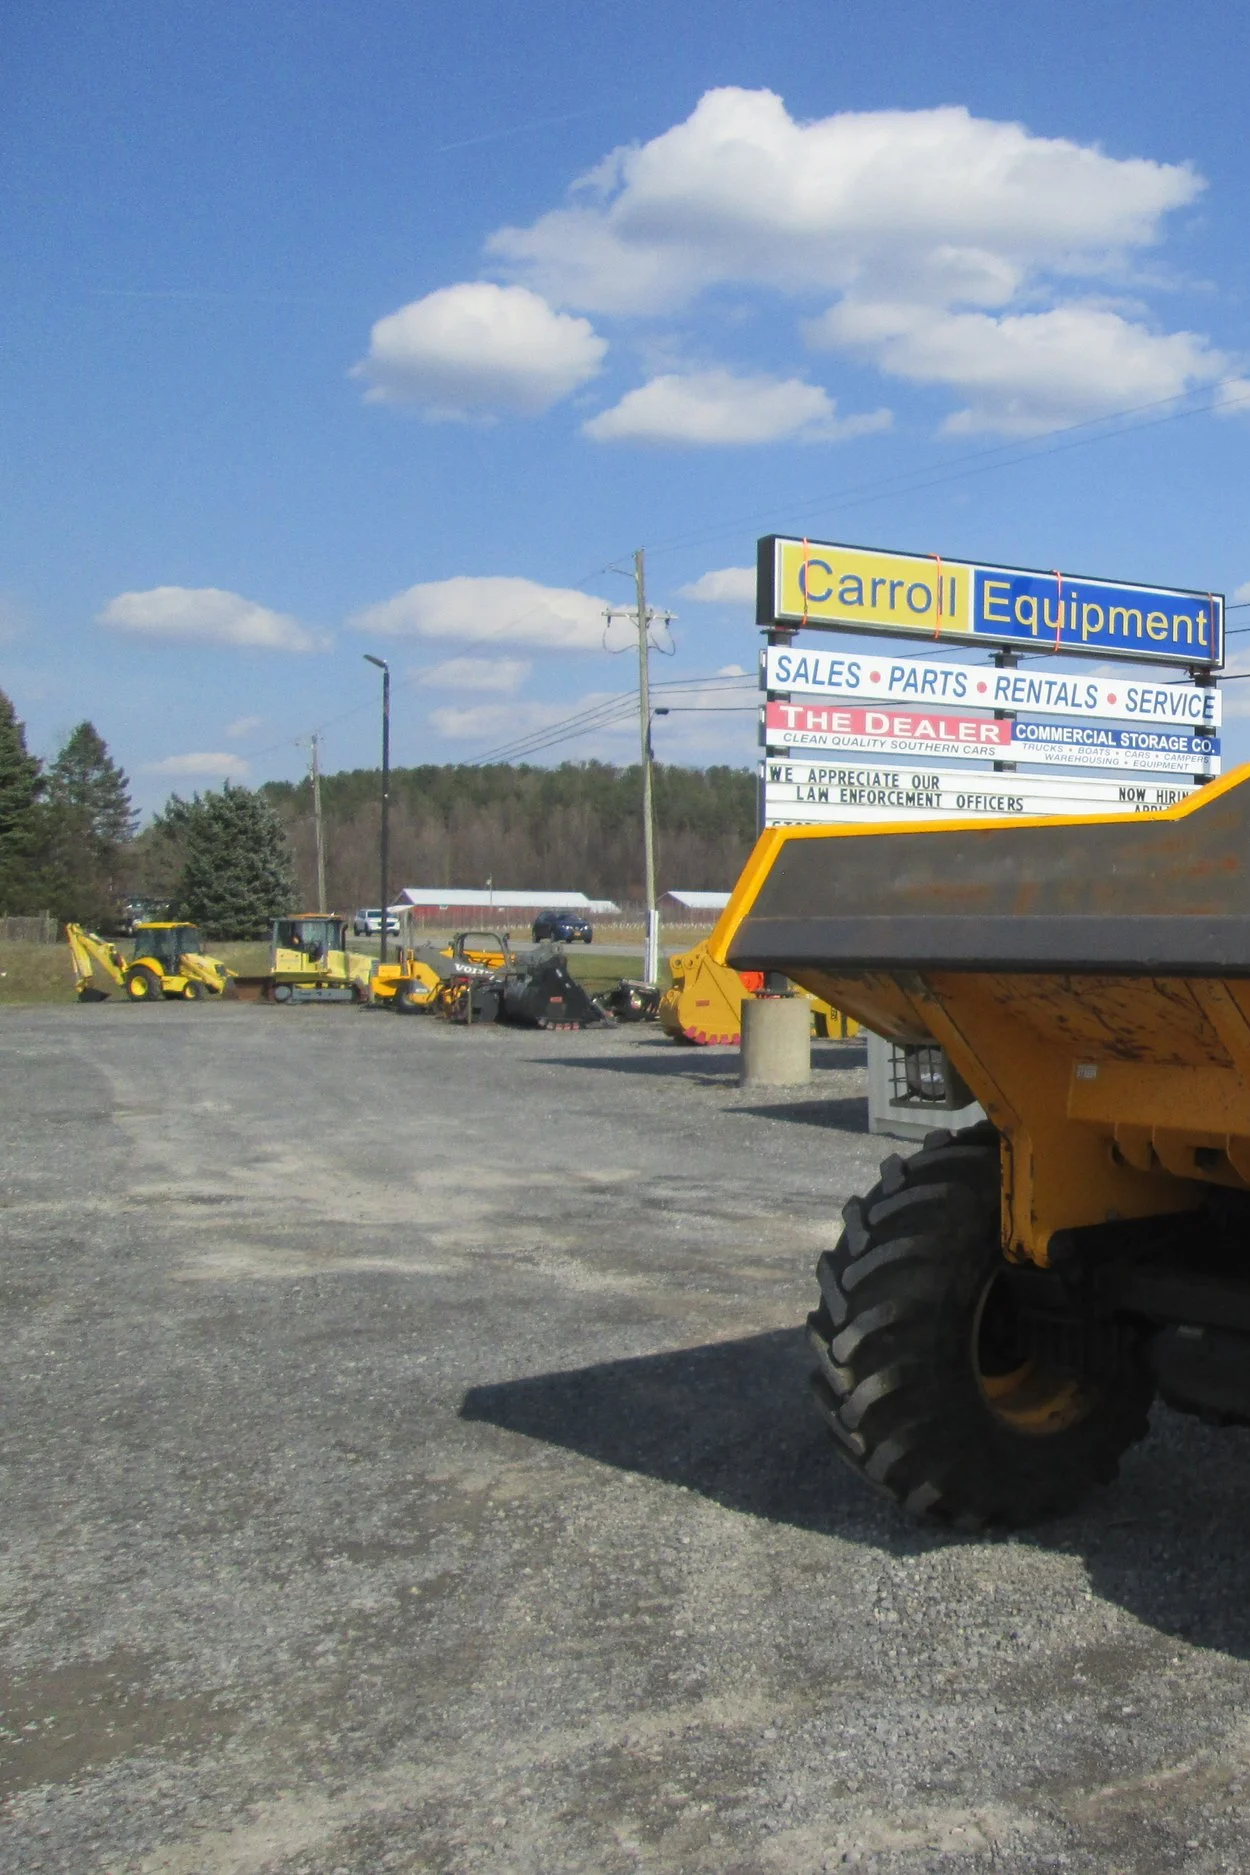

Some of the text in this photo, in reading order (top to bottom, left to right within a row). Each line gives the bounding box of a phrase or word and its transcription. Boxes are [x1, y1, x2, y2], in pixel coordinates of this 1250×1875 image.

[798, 559, 1208, 645] Carroll Equipment
[776, 655, 1215, 719] SALES PARTS RENTALS SERVICE
[779, 705, 1000, 743] THE DEALER
[783, 733, 996, 756] CLEAN QUALITY SOUTHERN CARS
[1016, 724, 1116, 746] COMMERCIAL
[1120, 733, 1188, 751] STORAGE
[1023, 742, 1209, 764] TRUCKS BOATS CARS CAMPERS
[1045, 753, 1190, 770] WAREHOUSING EQUIPMENT
[770, 766, 940, 790] WE APPRECIATE OUR
[796, 785, 1024, 812] LAW ENFORCEMENT OFFICERS
[1119, 787, 1146, 802] NOW
